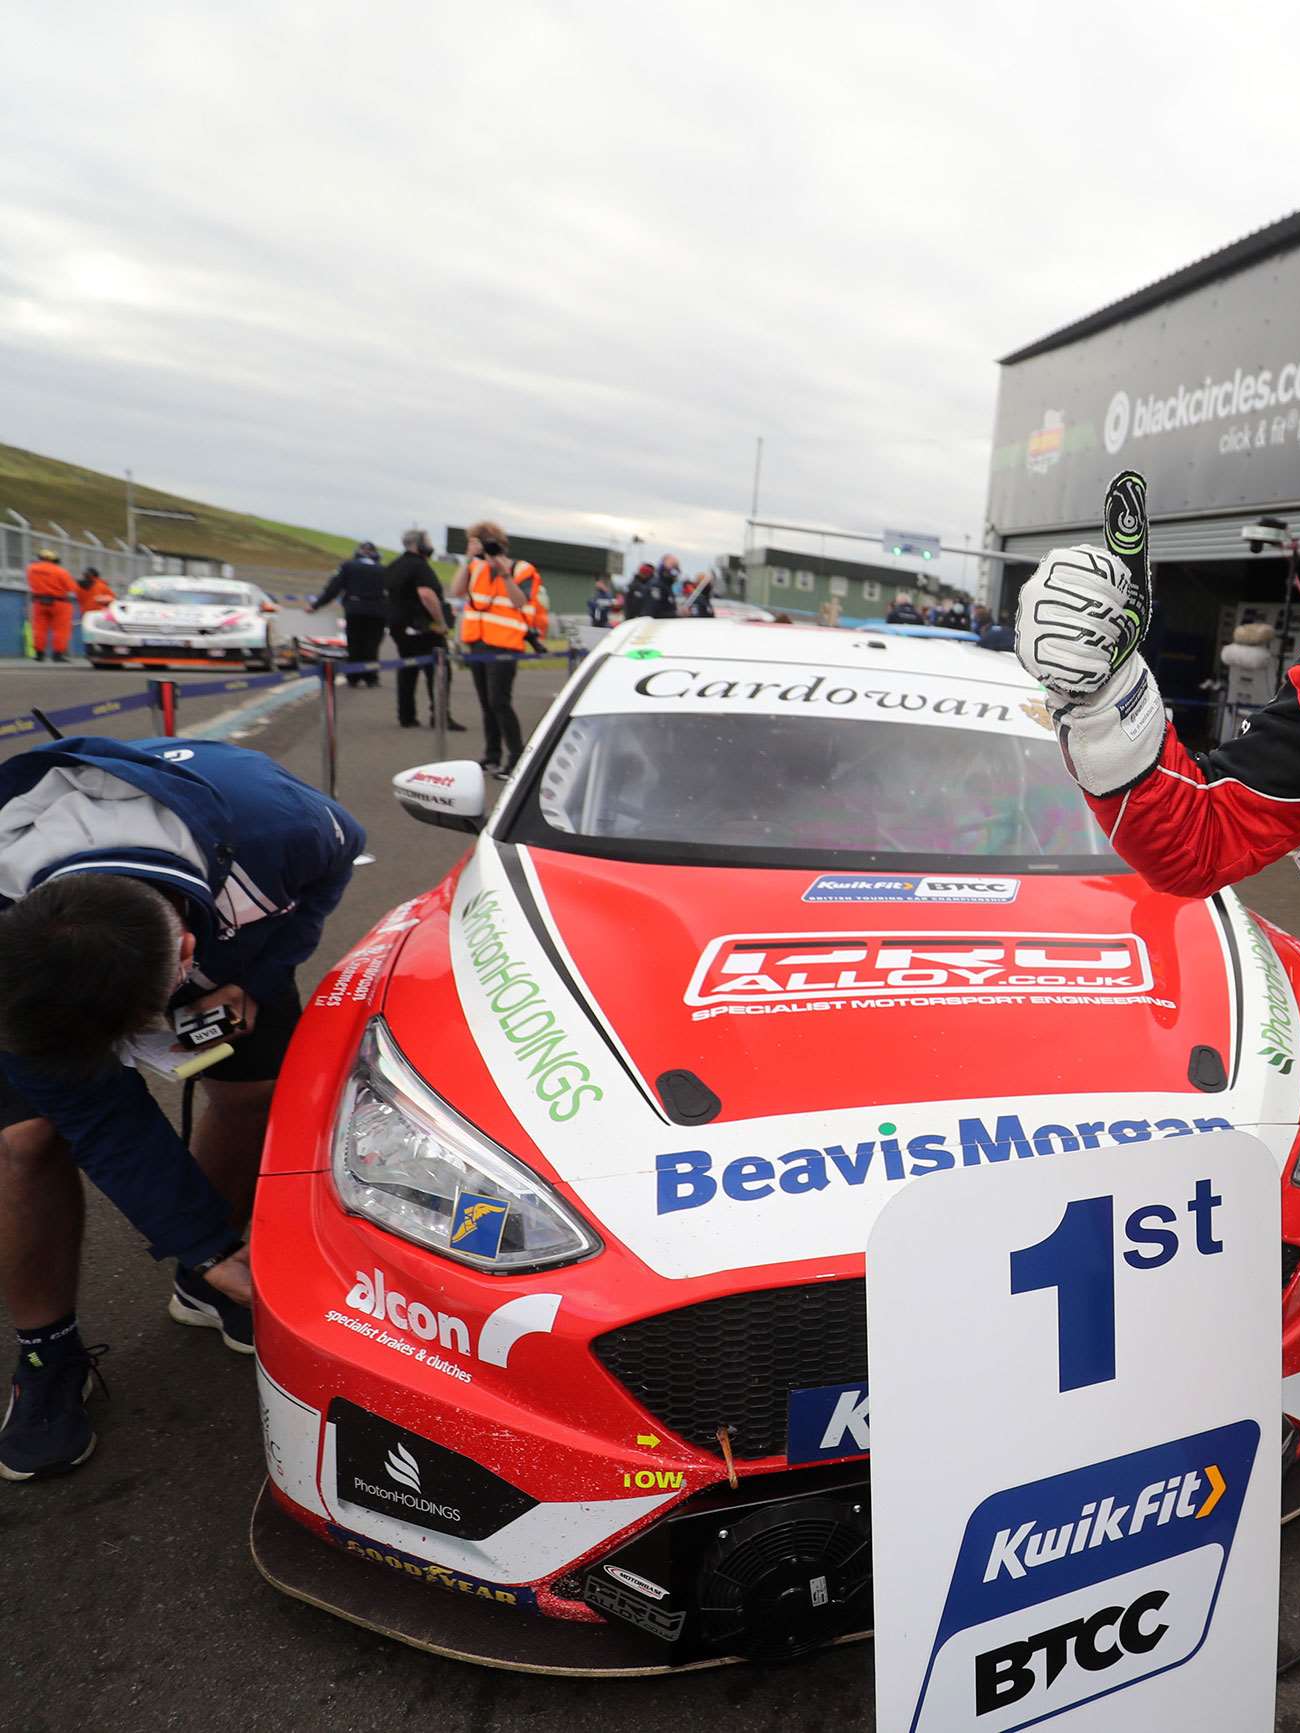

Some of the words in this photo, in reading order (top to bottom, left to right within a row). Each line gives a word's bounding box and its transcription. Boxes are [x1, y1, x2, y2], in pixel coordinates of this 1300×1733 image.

[1219, 421, 1250, 454] click
[1255, 418, 1267, 447] &
[634, 668, 1013, 722] Cardowan
[817, 880, 903, 891] KwikFit
[927, 882, 1007, 893] BTCC
[711, 968, 1135, 993] ALLOY.CO.UK
[721, 940, 1132, 975] PRO
[691, 1000, 847, 1022] SPECIALIST
[850, 995, 1032, 1010] MOTORSPORT
[1035, 995, 1177, 1009] ENGINEERING
[345, 1268, 471, 1357] alcon
[1009, 1179, 1223, 1394] 1st
[325, 1308, 378, 1339] specialist
[376, 1329, 413, 1356] brakes
[415, 1347, 426, 1361] &
[426, 1350, 473, 1383] clutches
[354, 1477, 461, 1522] PhotonHOLDINGS
[983, 1470, 1201, 1583] KwikFit
[346, 1539, 517, 1606] GOODYEAR
[976, 1590, 1170, 1717] BTCC
